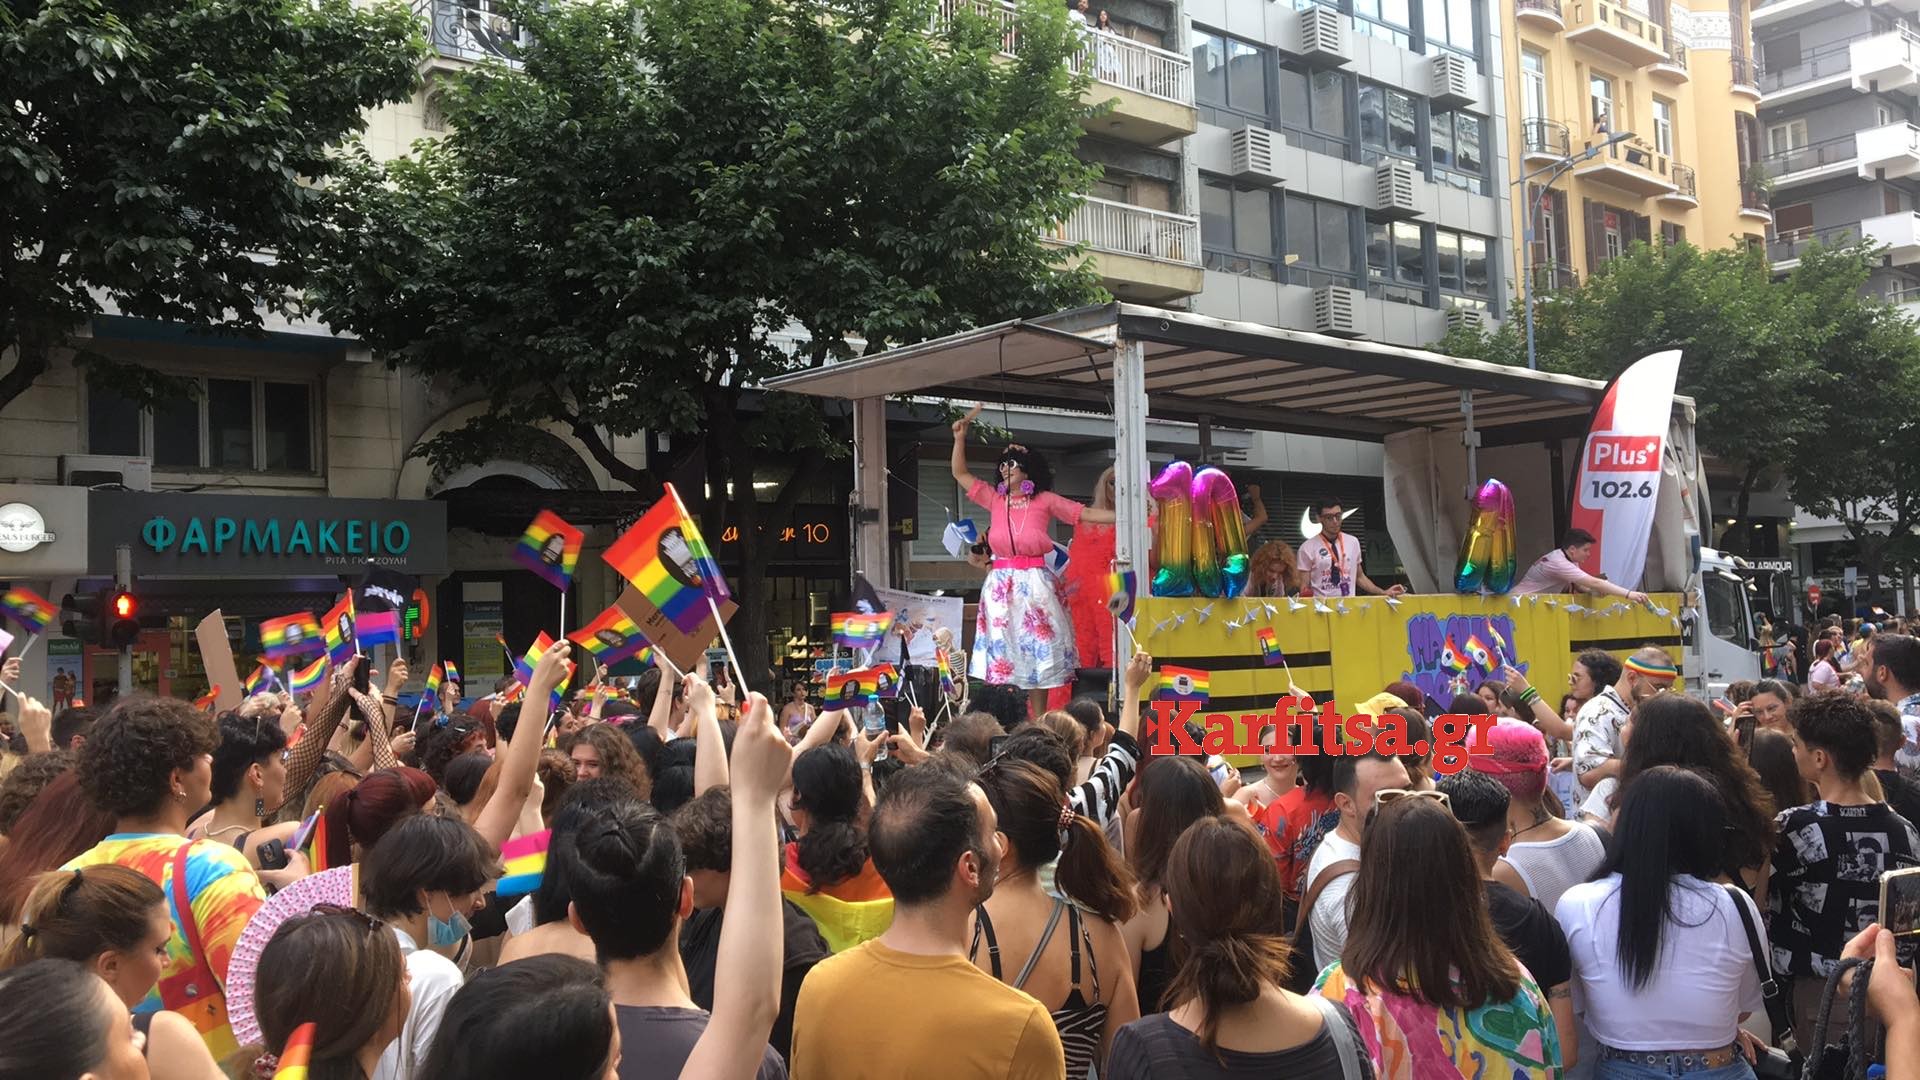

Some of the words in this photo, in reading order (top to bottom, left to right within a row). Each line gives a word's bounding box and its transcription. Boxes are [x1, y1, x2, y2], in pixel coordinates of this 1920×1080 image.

[1592, 480, 1652, 498] 102.6
[142, 516, 411, 554] ΦΑΡΜΑΚΕΙΟ
[802, 523, 829, 543] 10
[1758, 561, 1792, 571] ARMOUR
